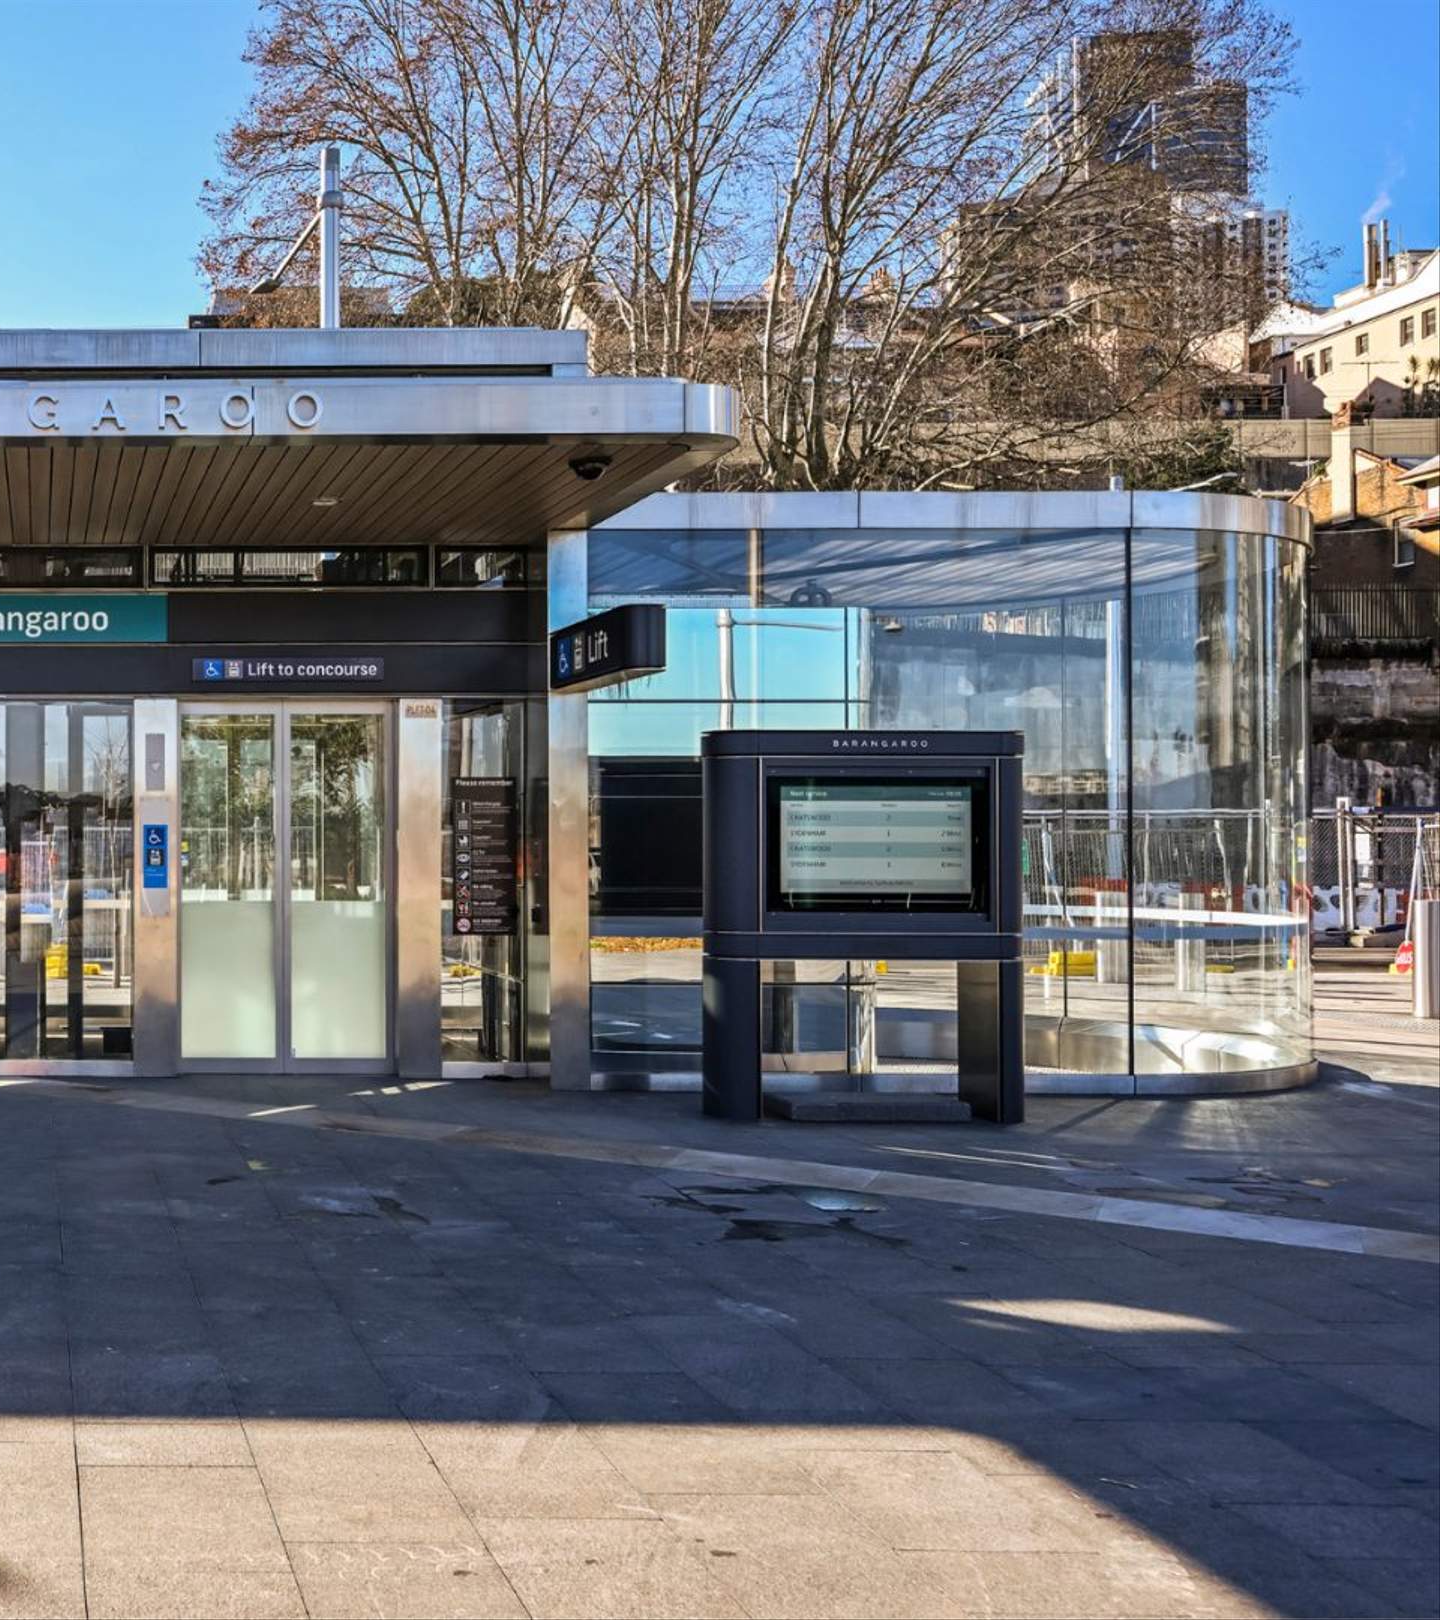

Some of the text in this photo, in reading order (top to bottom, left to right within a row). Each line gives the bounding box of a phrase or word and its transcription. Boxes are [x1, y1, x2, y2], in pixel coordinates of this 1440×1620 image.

[587, 629, 609, 664] Lift
[248, 662, 377, 676] Lift to concourse
[832, 739, 929, 748] BARANGAROO
